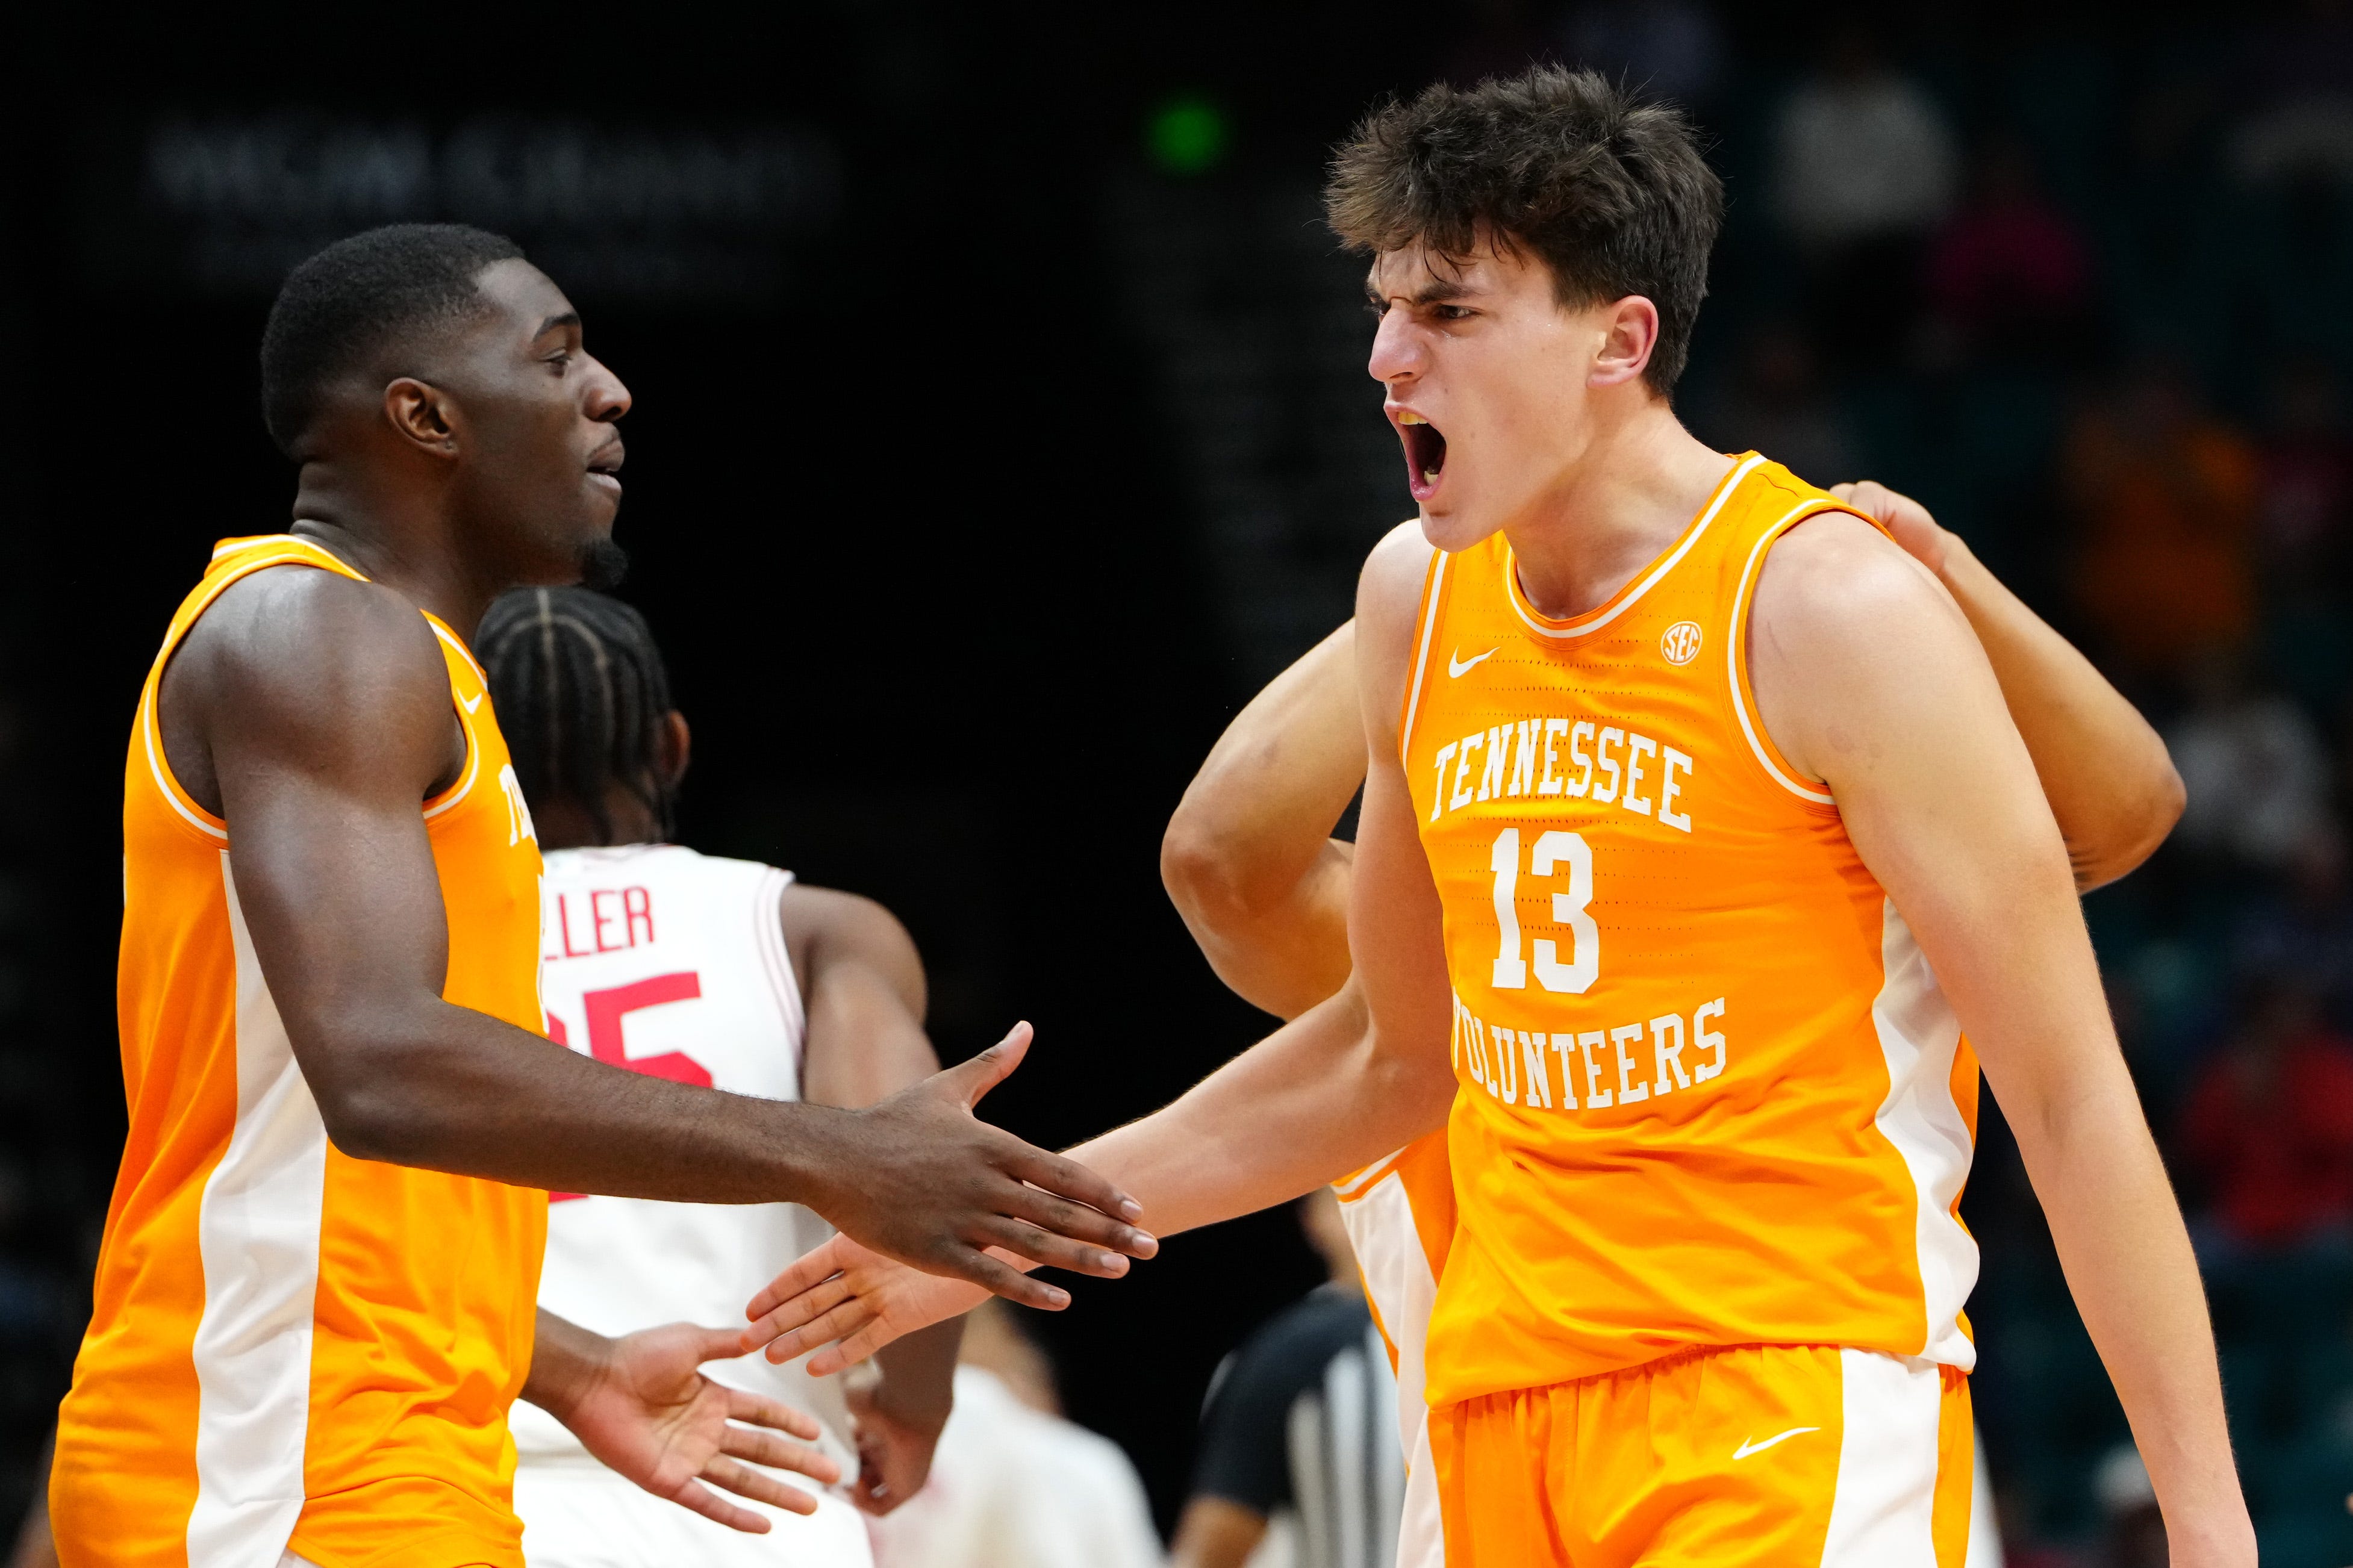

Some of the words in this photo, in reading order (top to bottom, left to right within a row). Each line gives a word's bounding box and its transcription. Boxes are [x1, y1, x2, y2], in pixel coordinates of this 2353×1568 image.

[1665, 625, 1699, 661] SEC
[1430, 718, 1693, 833] TENNESSEE
[1490, 827, 1600, 994] 13
